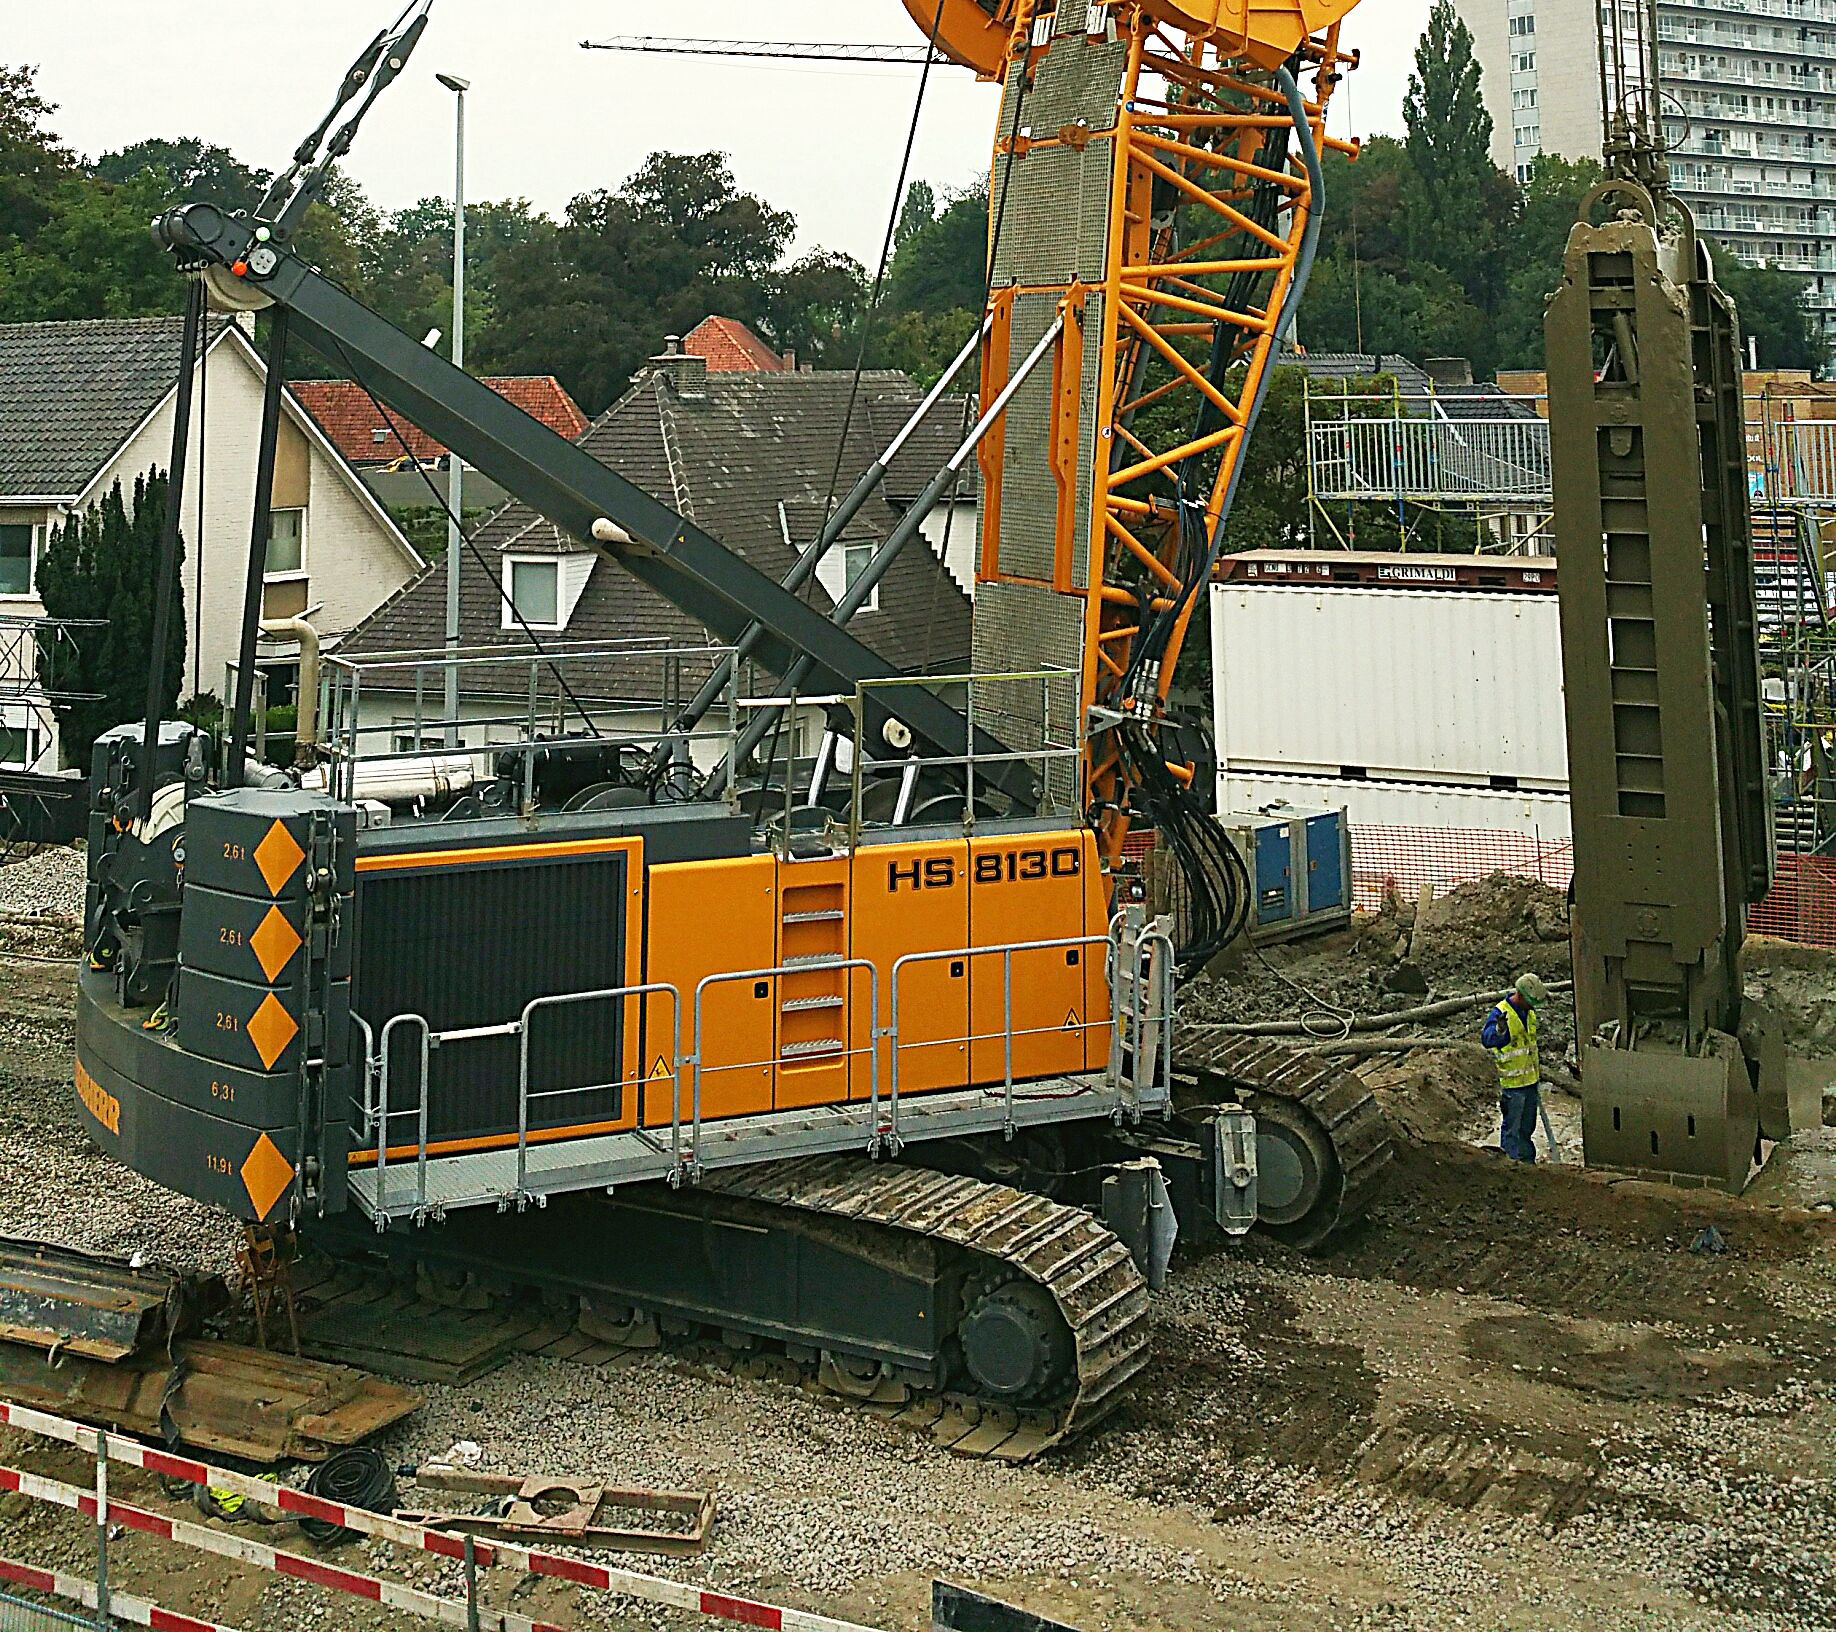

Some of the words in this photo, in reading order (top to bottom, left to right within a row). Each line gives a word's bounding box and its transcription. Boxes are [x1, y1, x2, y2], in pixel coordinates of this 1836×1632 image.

[1391, 566, 1456, 581] GRIMALDI
[888, 855, 955, 893] HS
[974, 847, 1081, 885] 8130
